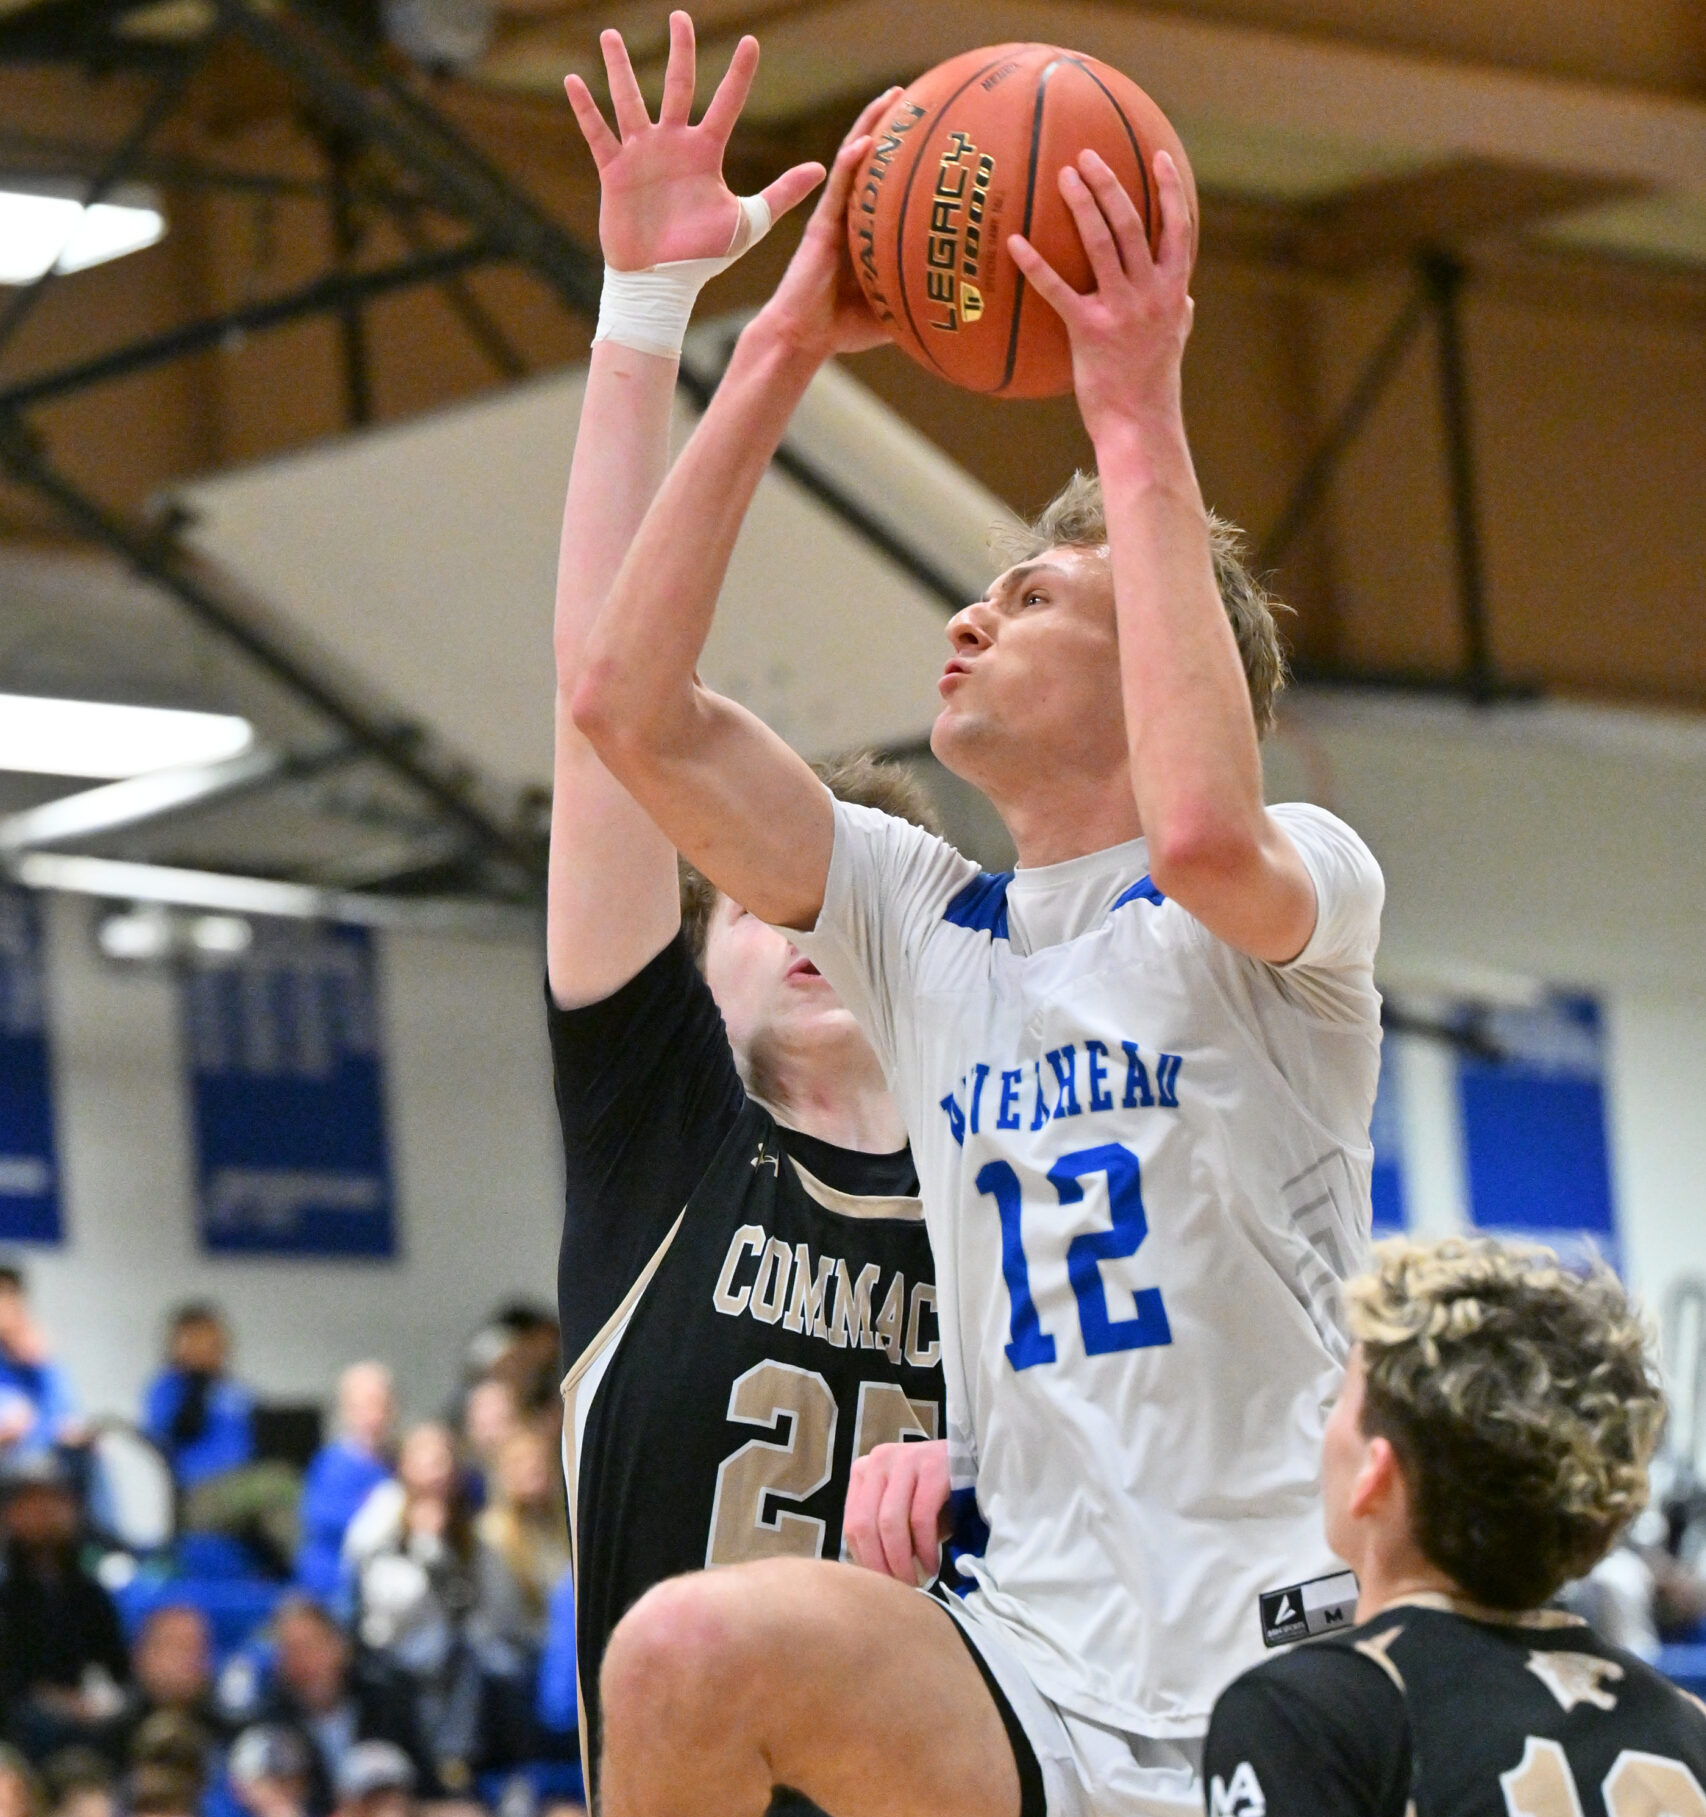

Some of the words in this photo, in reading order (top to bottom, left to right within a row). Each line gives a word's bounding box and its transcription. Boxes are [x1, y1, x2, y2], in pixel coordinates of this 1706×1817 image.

[926, 131, 977, 333] LEGACY
[963, 152, 995, 278] 1000
[975, 1142, 1173, 1372] 12
[1324, 1607, 1344, 1624] M
